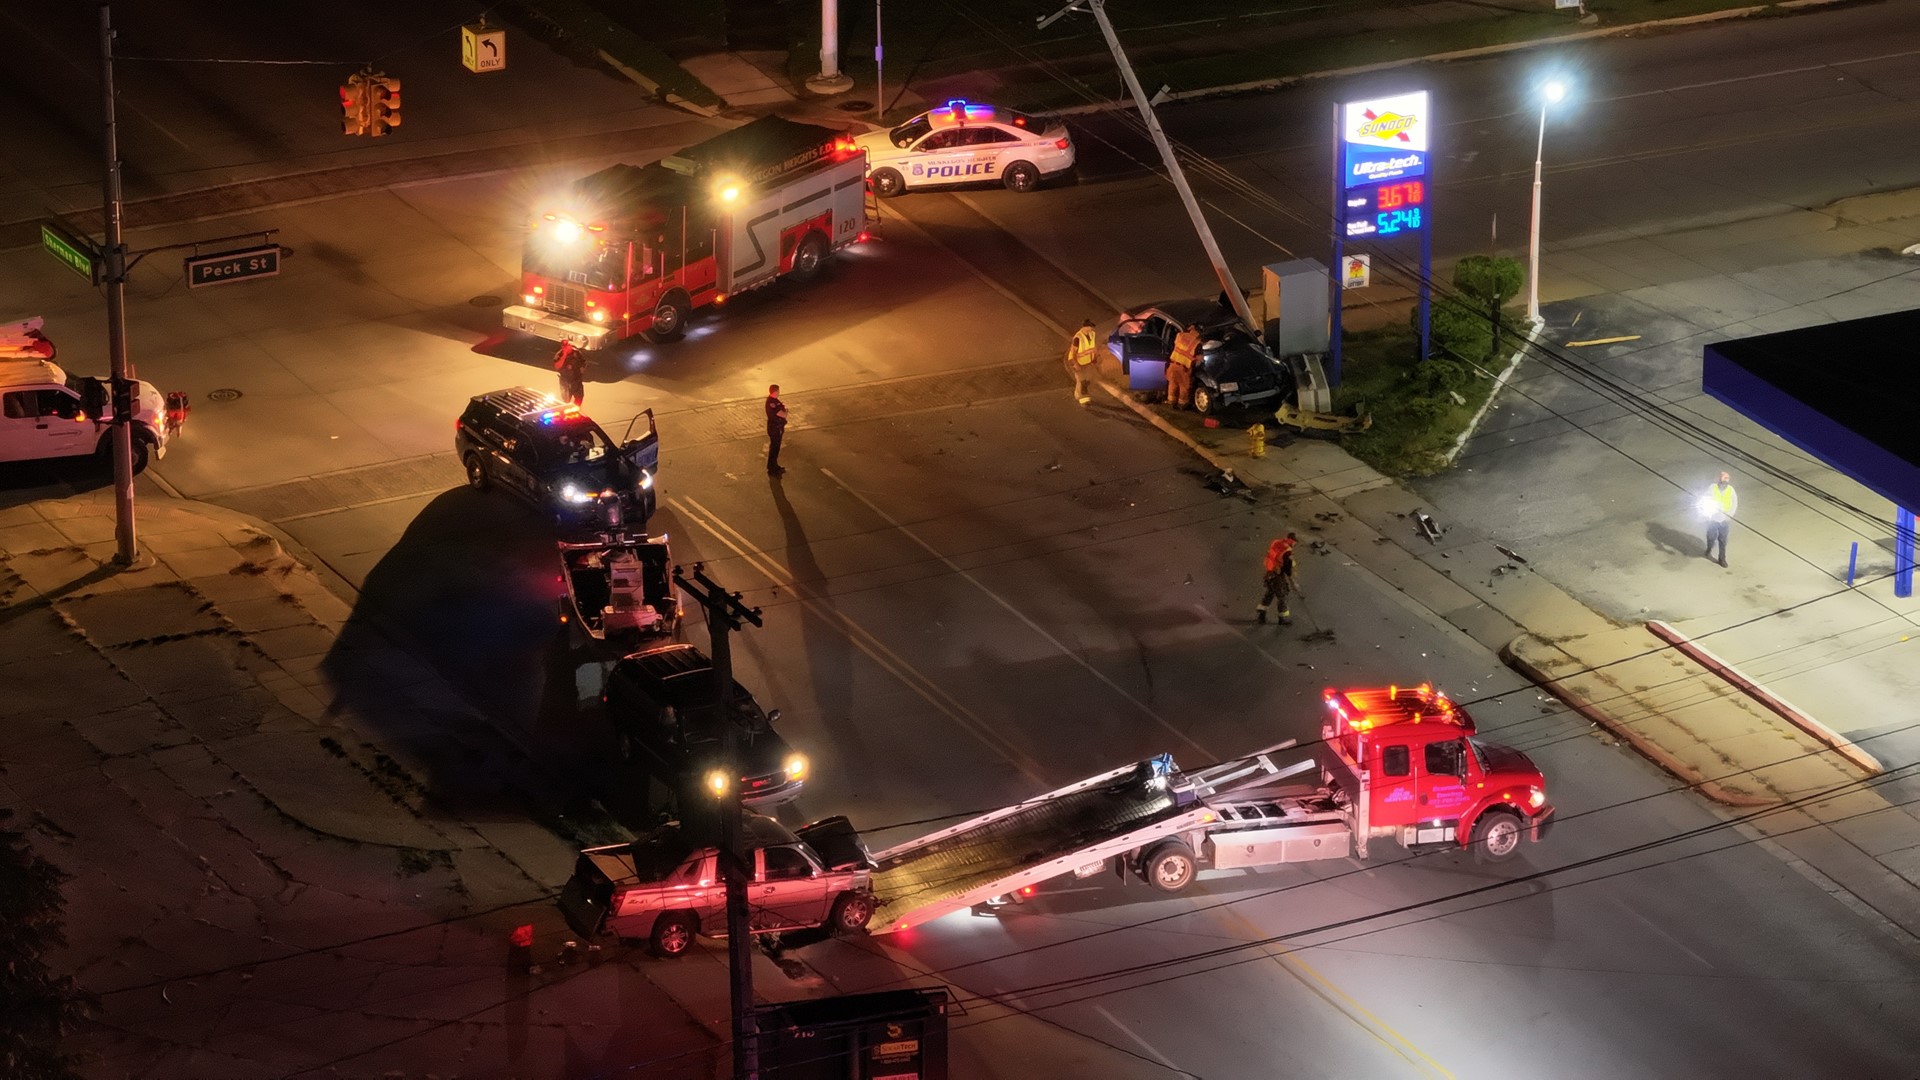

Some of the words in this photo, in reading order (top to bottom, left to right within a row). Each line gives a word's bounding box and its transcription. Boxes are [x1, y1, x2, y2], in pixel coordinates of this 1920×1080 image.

[480, 59, 501, 68] ONLY
[1361, 117, 1413, 135] SUNOCO
[783, 147, 818, 170] HEIGHTS
[927, 162, 995, 178] POLICE
[840, 217, 856, 234] 120
[45, 234, 73, 263] Sherman
[74, 255, 90, 276] Blvd
[203, 262, 241, 278] Peck
[249, 257, 267, 270] St
